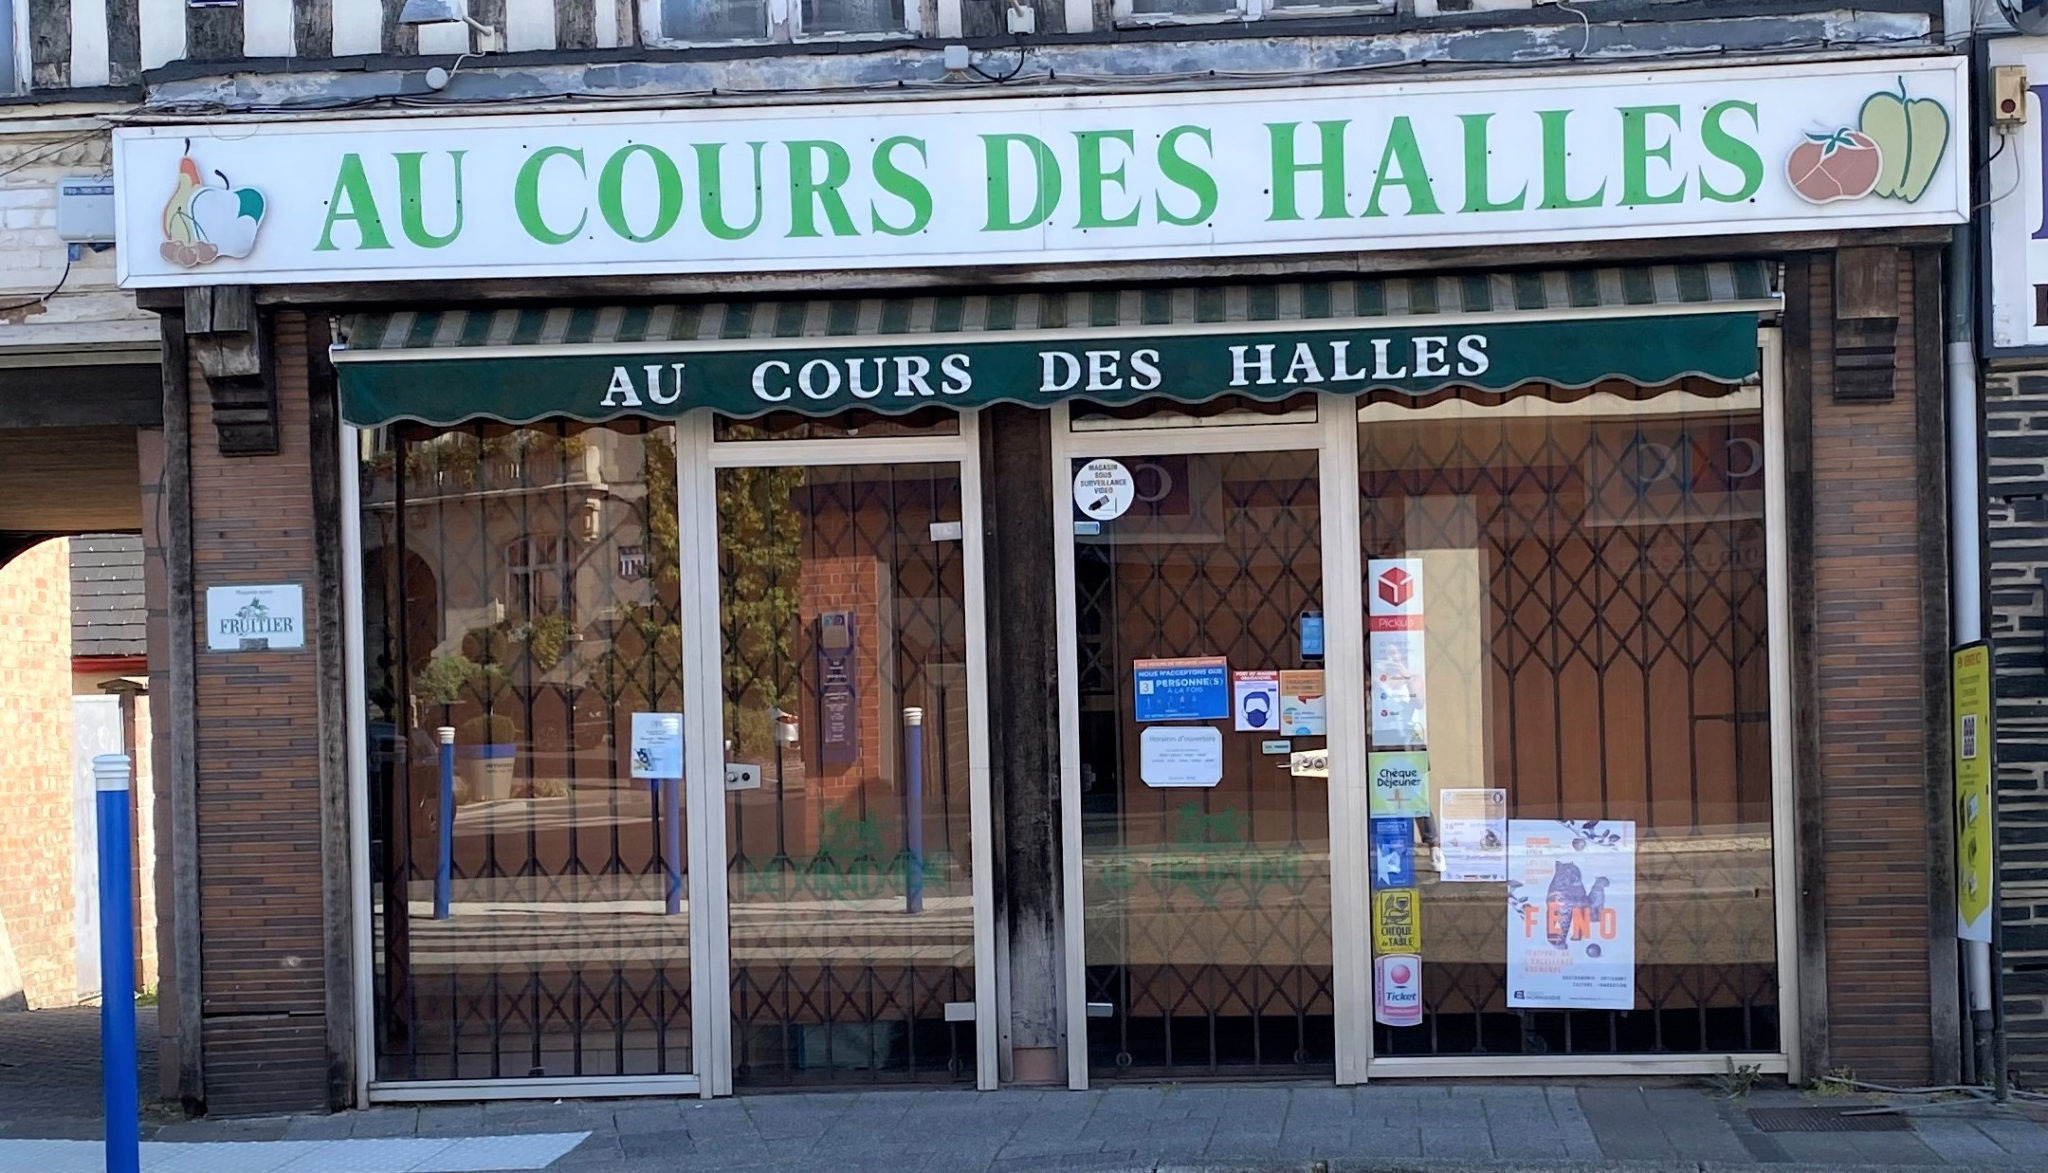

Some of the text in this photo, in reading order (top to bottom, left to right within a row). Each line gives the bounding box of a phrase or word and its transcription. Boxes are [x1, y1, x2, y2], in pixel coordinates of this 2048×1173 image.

[313, 99, 1765, 252] AU COURS DES HALLES
[600, 333, 1490, 408] AU COURS DES HALLES
[1088, 463, 1118, 471] MAGASIN
[1094, 471, 1113, 479] SOUS
[1080, 478, 1127, 487] SURVEILLANCE
[220, 616, 294, 635] FRUITIER
[1378, 616, 1415, 629] Pickup
[1159, 669, 1207, 677] N'ACCEPTONS
[1155, 677, 1224, 688] PERSONNE(S)
[1379, 767, 1418, 779] Chèque
[1376, 778, 1422, 789] Déjeuner
[1388, 936, 1413, 947] TABLE
[1386, 991, 1417, 1001] Ticket
